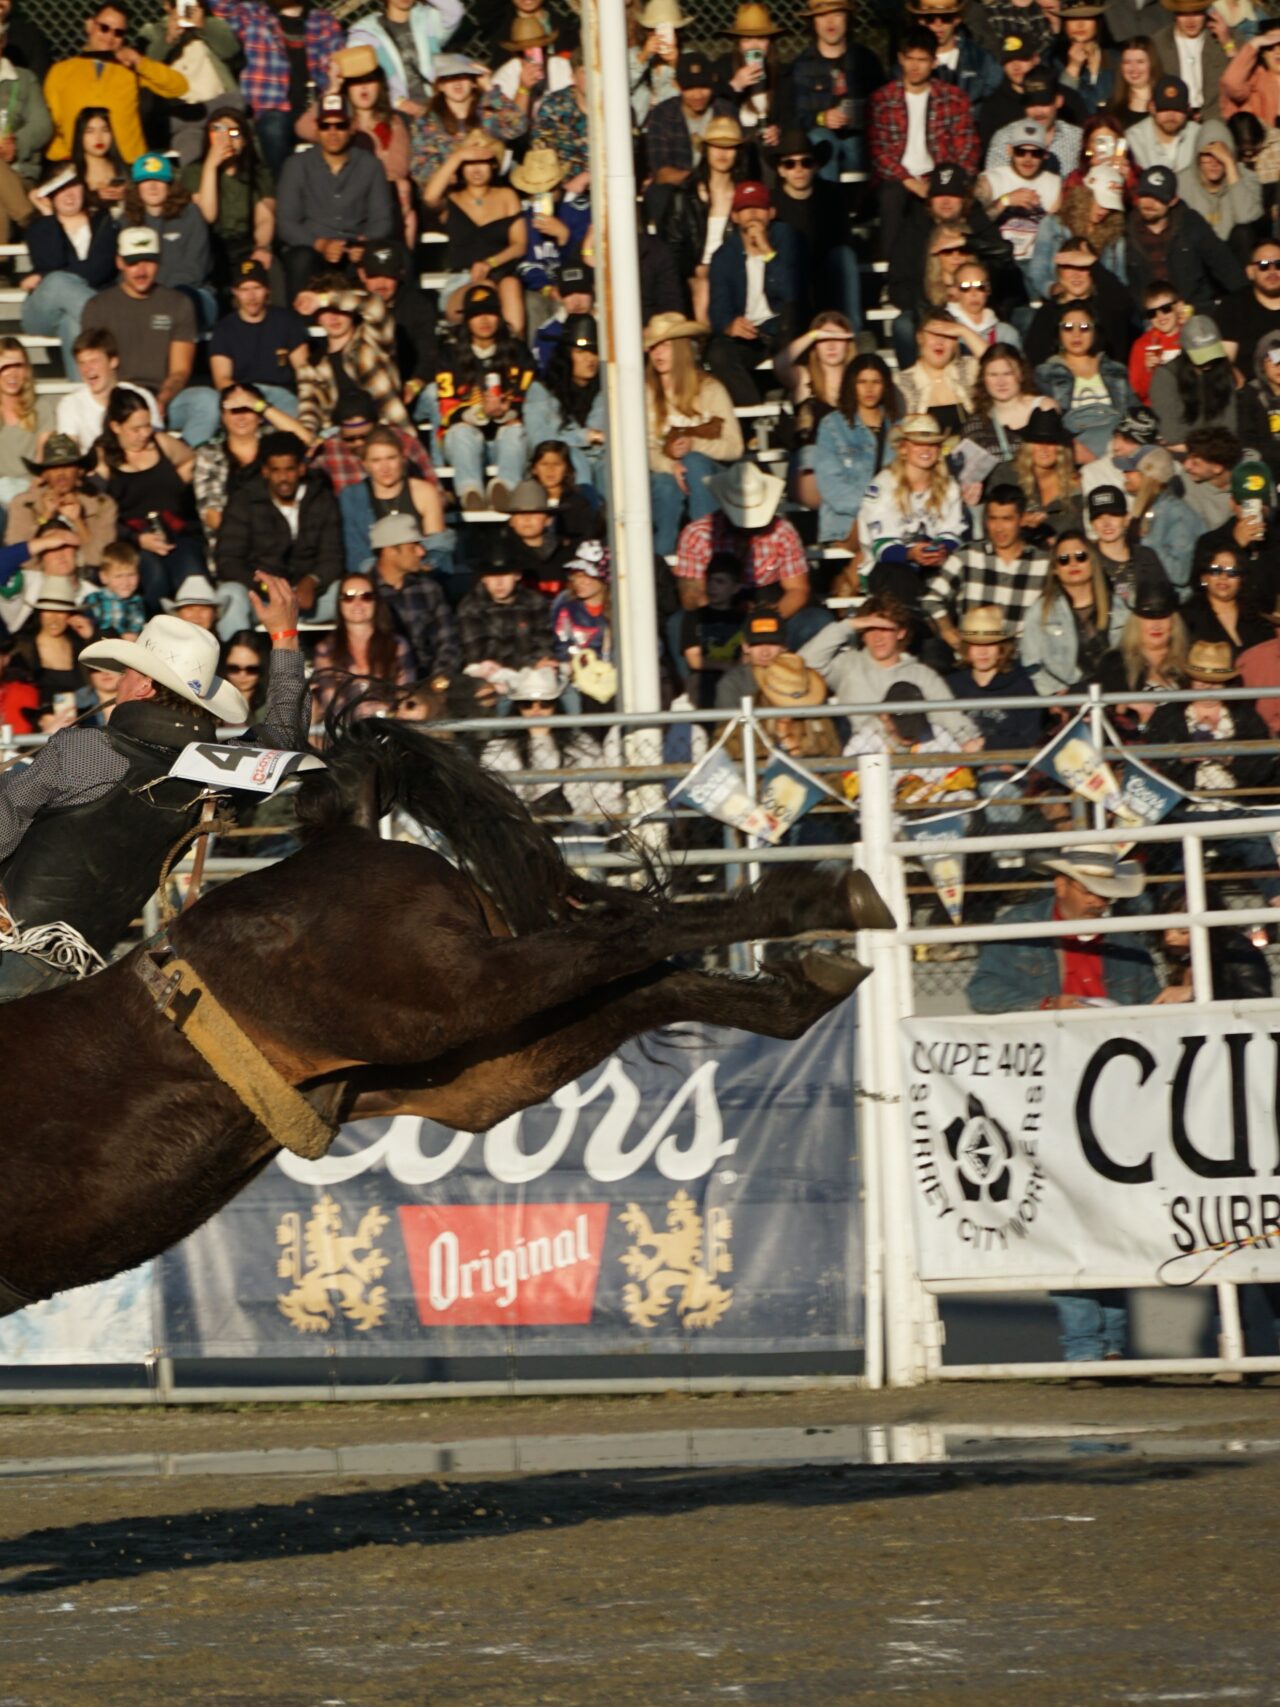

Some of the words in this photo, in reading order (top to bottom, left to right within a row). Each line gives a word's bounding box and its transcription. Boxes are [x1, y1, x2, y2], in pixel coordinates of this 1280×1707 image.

[195, 743, 263, 772] 4
[912, 1041, 991, 1076] CUPE
[997, 1043, 1046, 1077] 402
[1075, 1032, 1280, 1184] CU
[429, 1214, 592, 1311] Original
